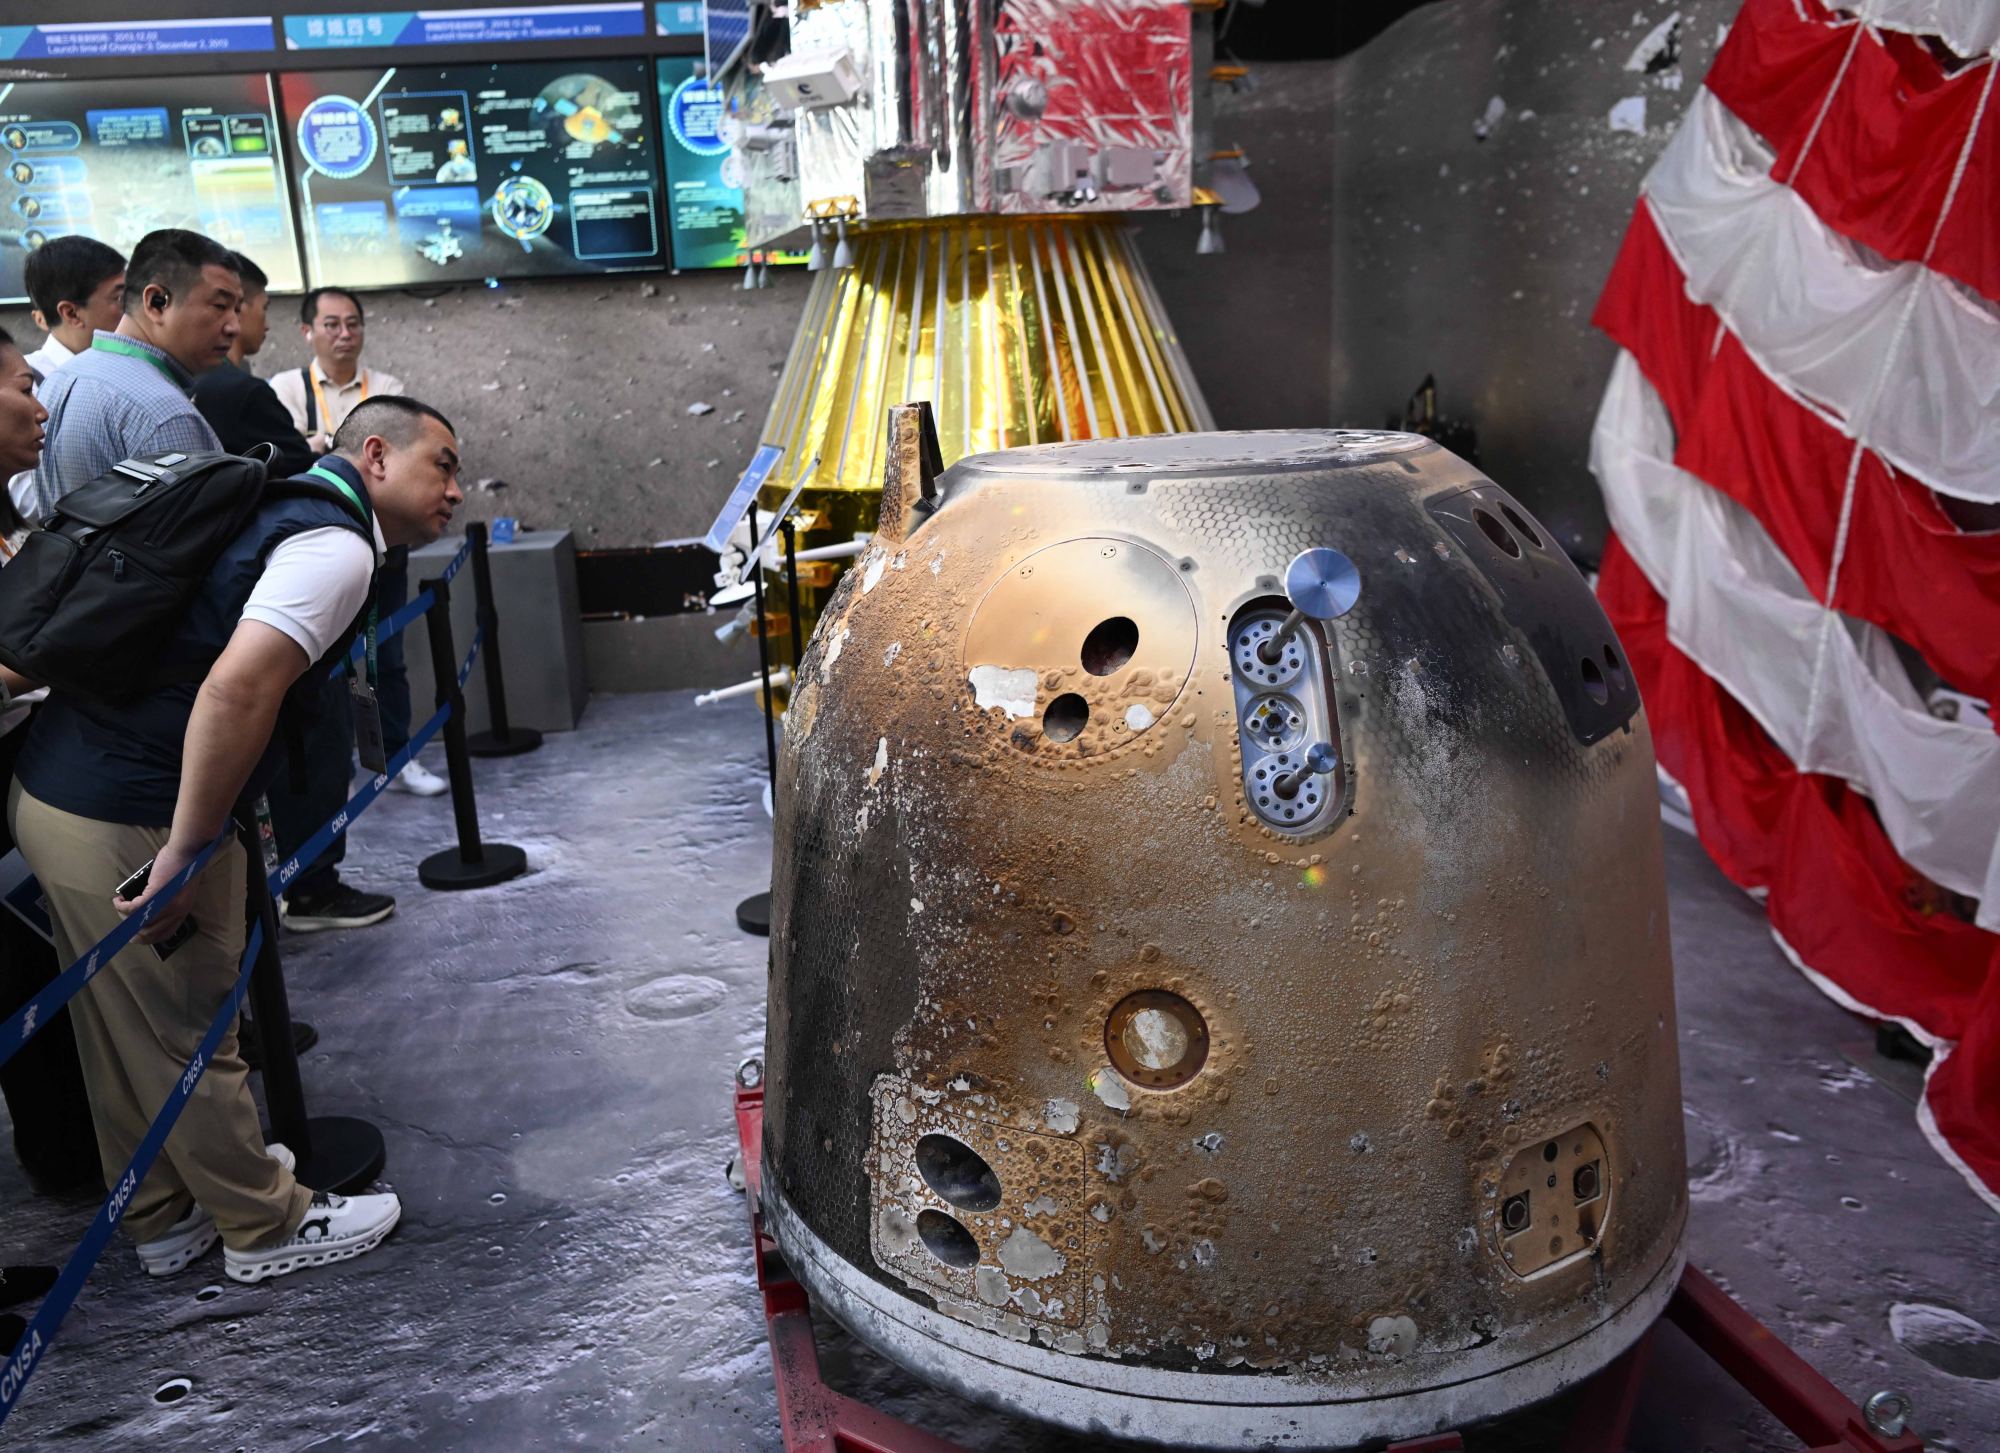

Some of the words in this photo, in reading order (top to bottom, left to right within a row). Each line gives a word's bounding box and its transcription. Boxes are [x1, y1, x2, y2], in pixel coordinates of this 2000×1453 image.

[331, 811, 348, 833] CNSA
[280, 857, 300, 884] CNSA
[182, 1051, 203, 1095] CNSA
[108, 1168, 136, 1223] CNSA
[1, 1329, 42, 1403] CNSA
